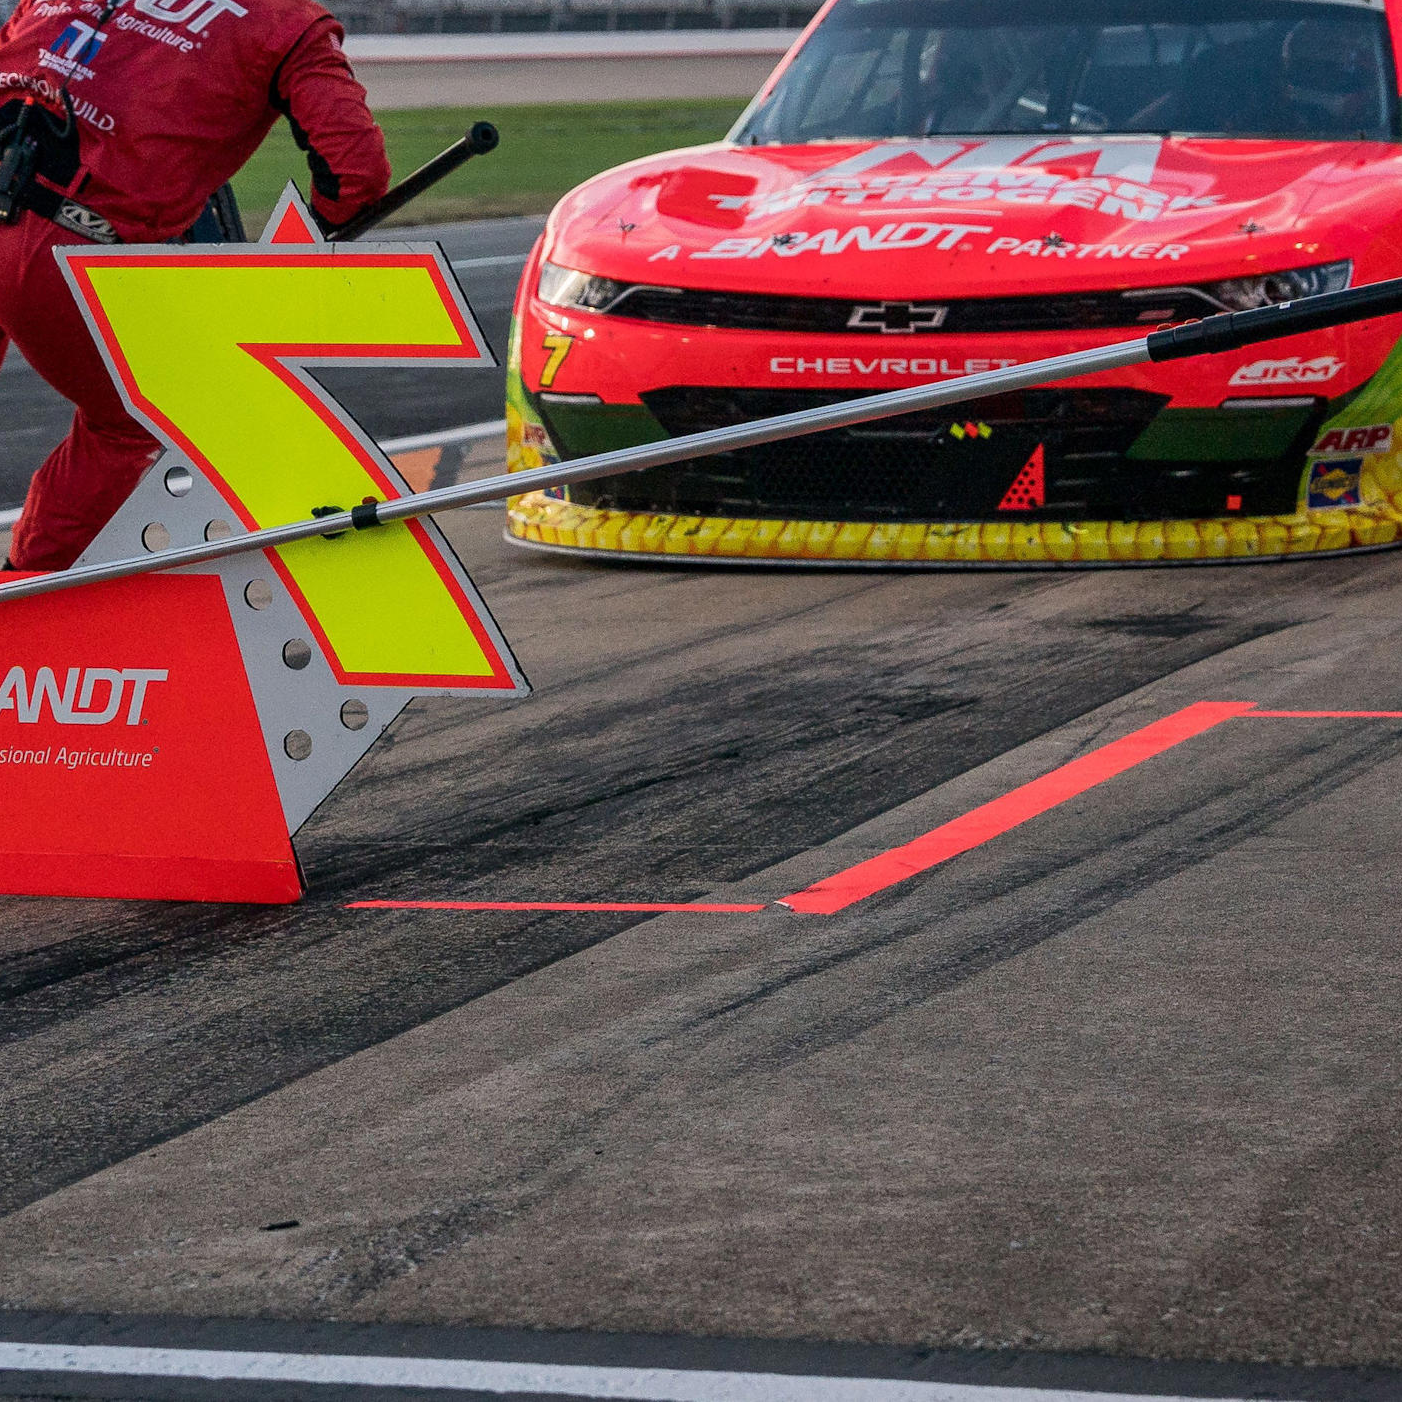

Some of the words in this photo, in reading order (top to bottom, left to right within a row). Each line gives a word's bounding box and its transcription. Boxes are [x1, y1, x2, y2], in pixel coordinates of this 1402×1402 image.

[64, 94, 116, 132] UILD
[647, 245, 681, 262] A
[690, 221, 993, 261] BRANDT
[986, 236, 1191, 262] PARTNER
[539, 333, 574, 388] 7
[1311, 425, 1392, 454] ARP
[65, 253, 517, 691] 7
[55, 746, 153, 770] Agriculture
